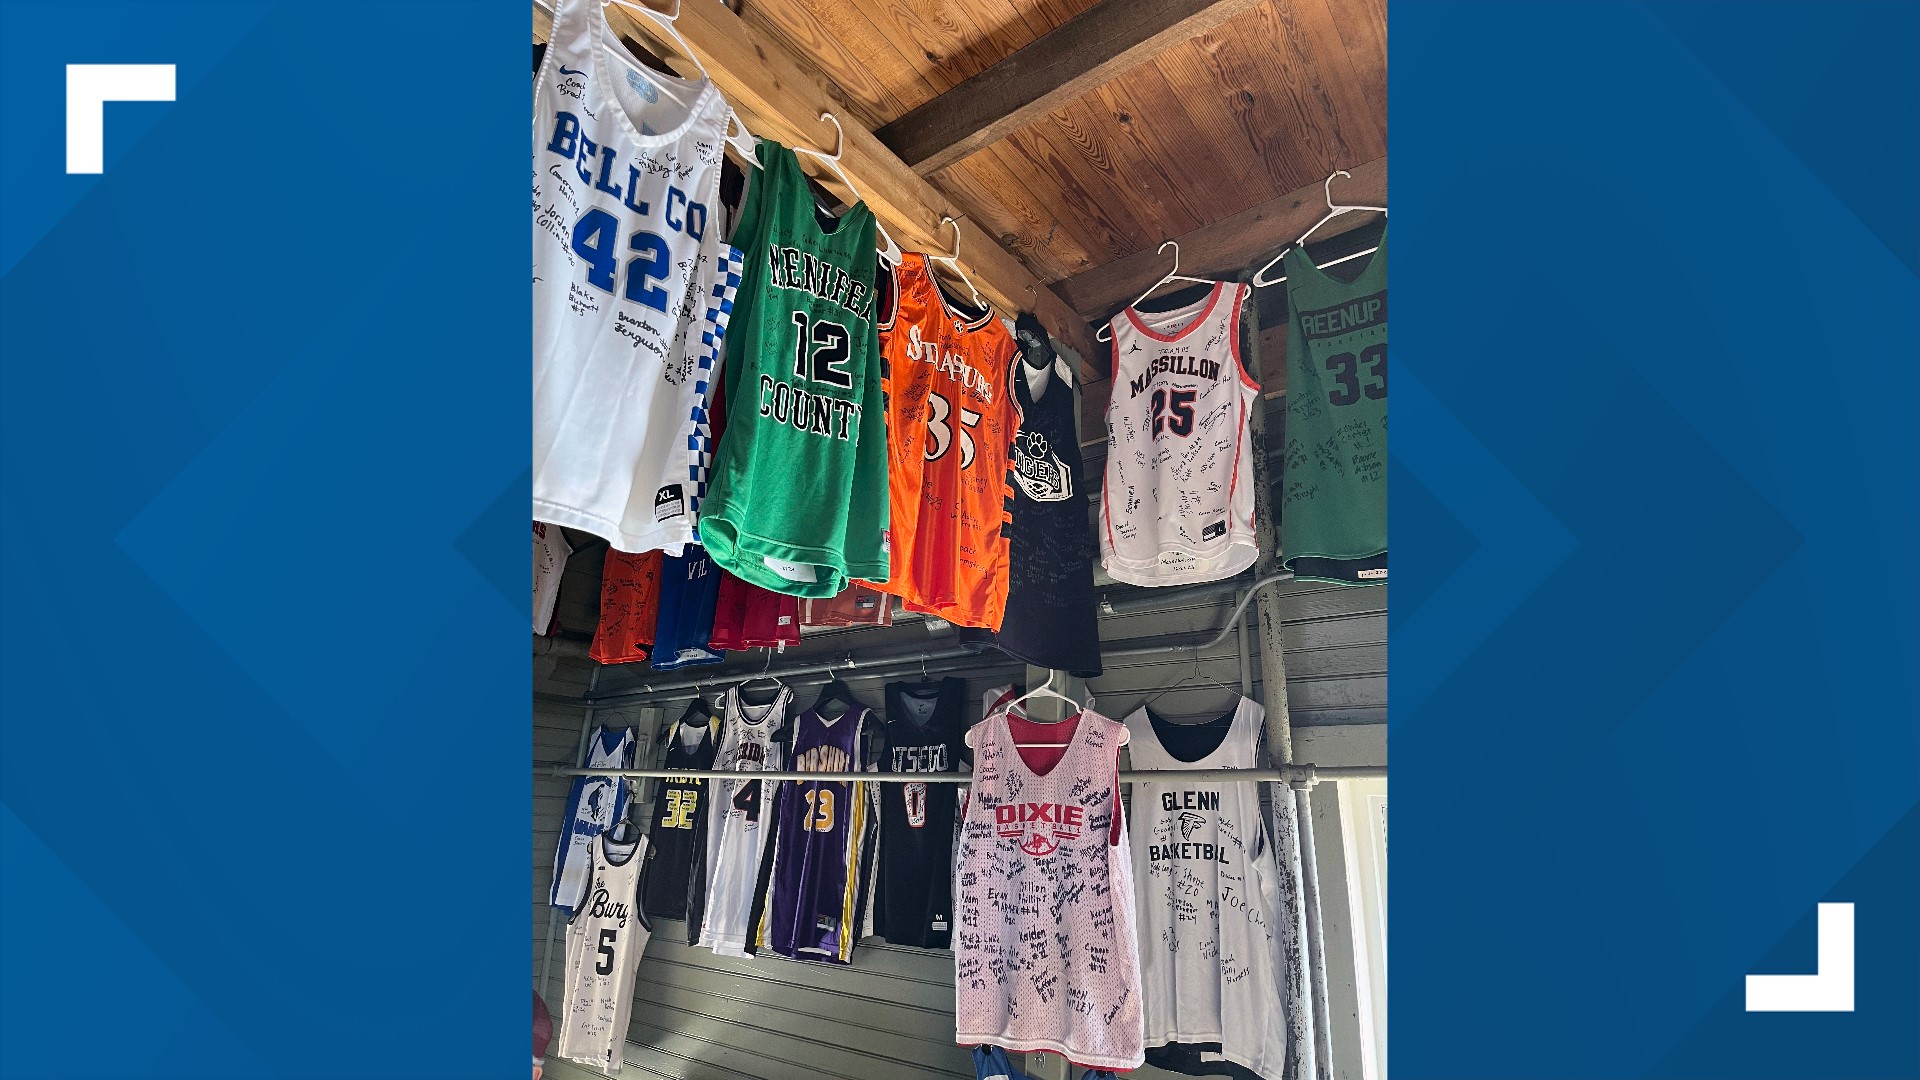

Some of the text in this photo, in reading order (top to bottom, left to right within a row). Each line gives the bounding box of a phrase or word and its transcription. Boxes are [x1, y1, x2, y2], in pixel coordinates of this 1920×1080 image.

[547, 111, 707, 243] BELL CO
[571, 205, 673, 317] 42
[570, 282, 595, 302] Blake
[1301, 298, 1381, 337] REENUP
[791, 310, 853, 389] 12
[1130, 355, 1221, 400] MASSILLON
[1325, 343, 1388, 406] 33
[1151, 387, 1198, 442] 25
[658, 488, 675, 502] XL
[661, 789, 698, 830] 32
[733, 778, 762, 823] 4
[995, 803, 1084, 827] DIXIE
[1161, 791, 1220, 812] GLENN
[996, 823, 1082, 834] BASKETBALL
[588, 889, 628, 928] Bury
[1178, 912, 1197, 925] #24
[595, 928, 618, 976] 5
